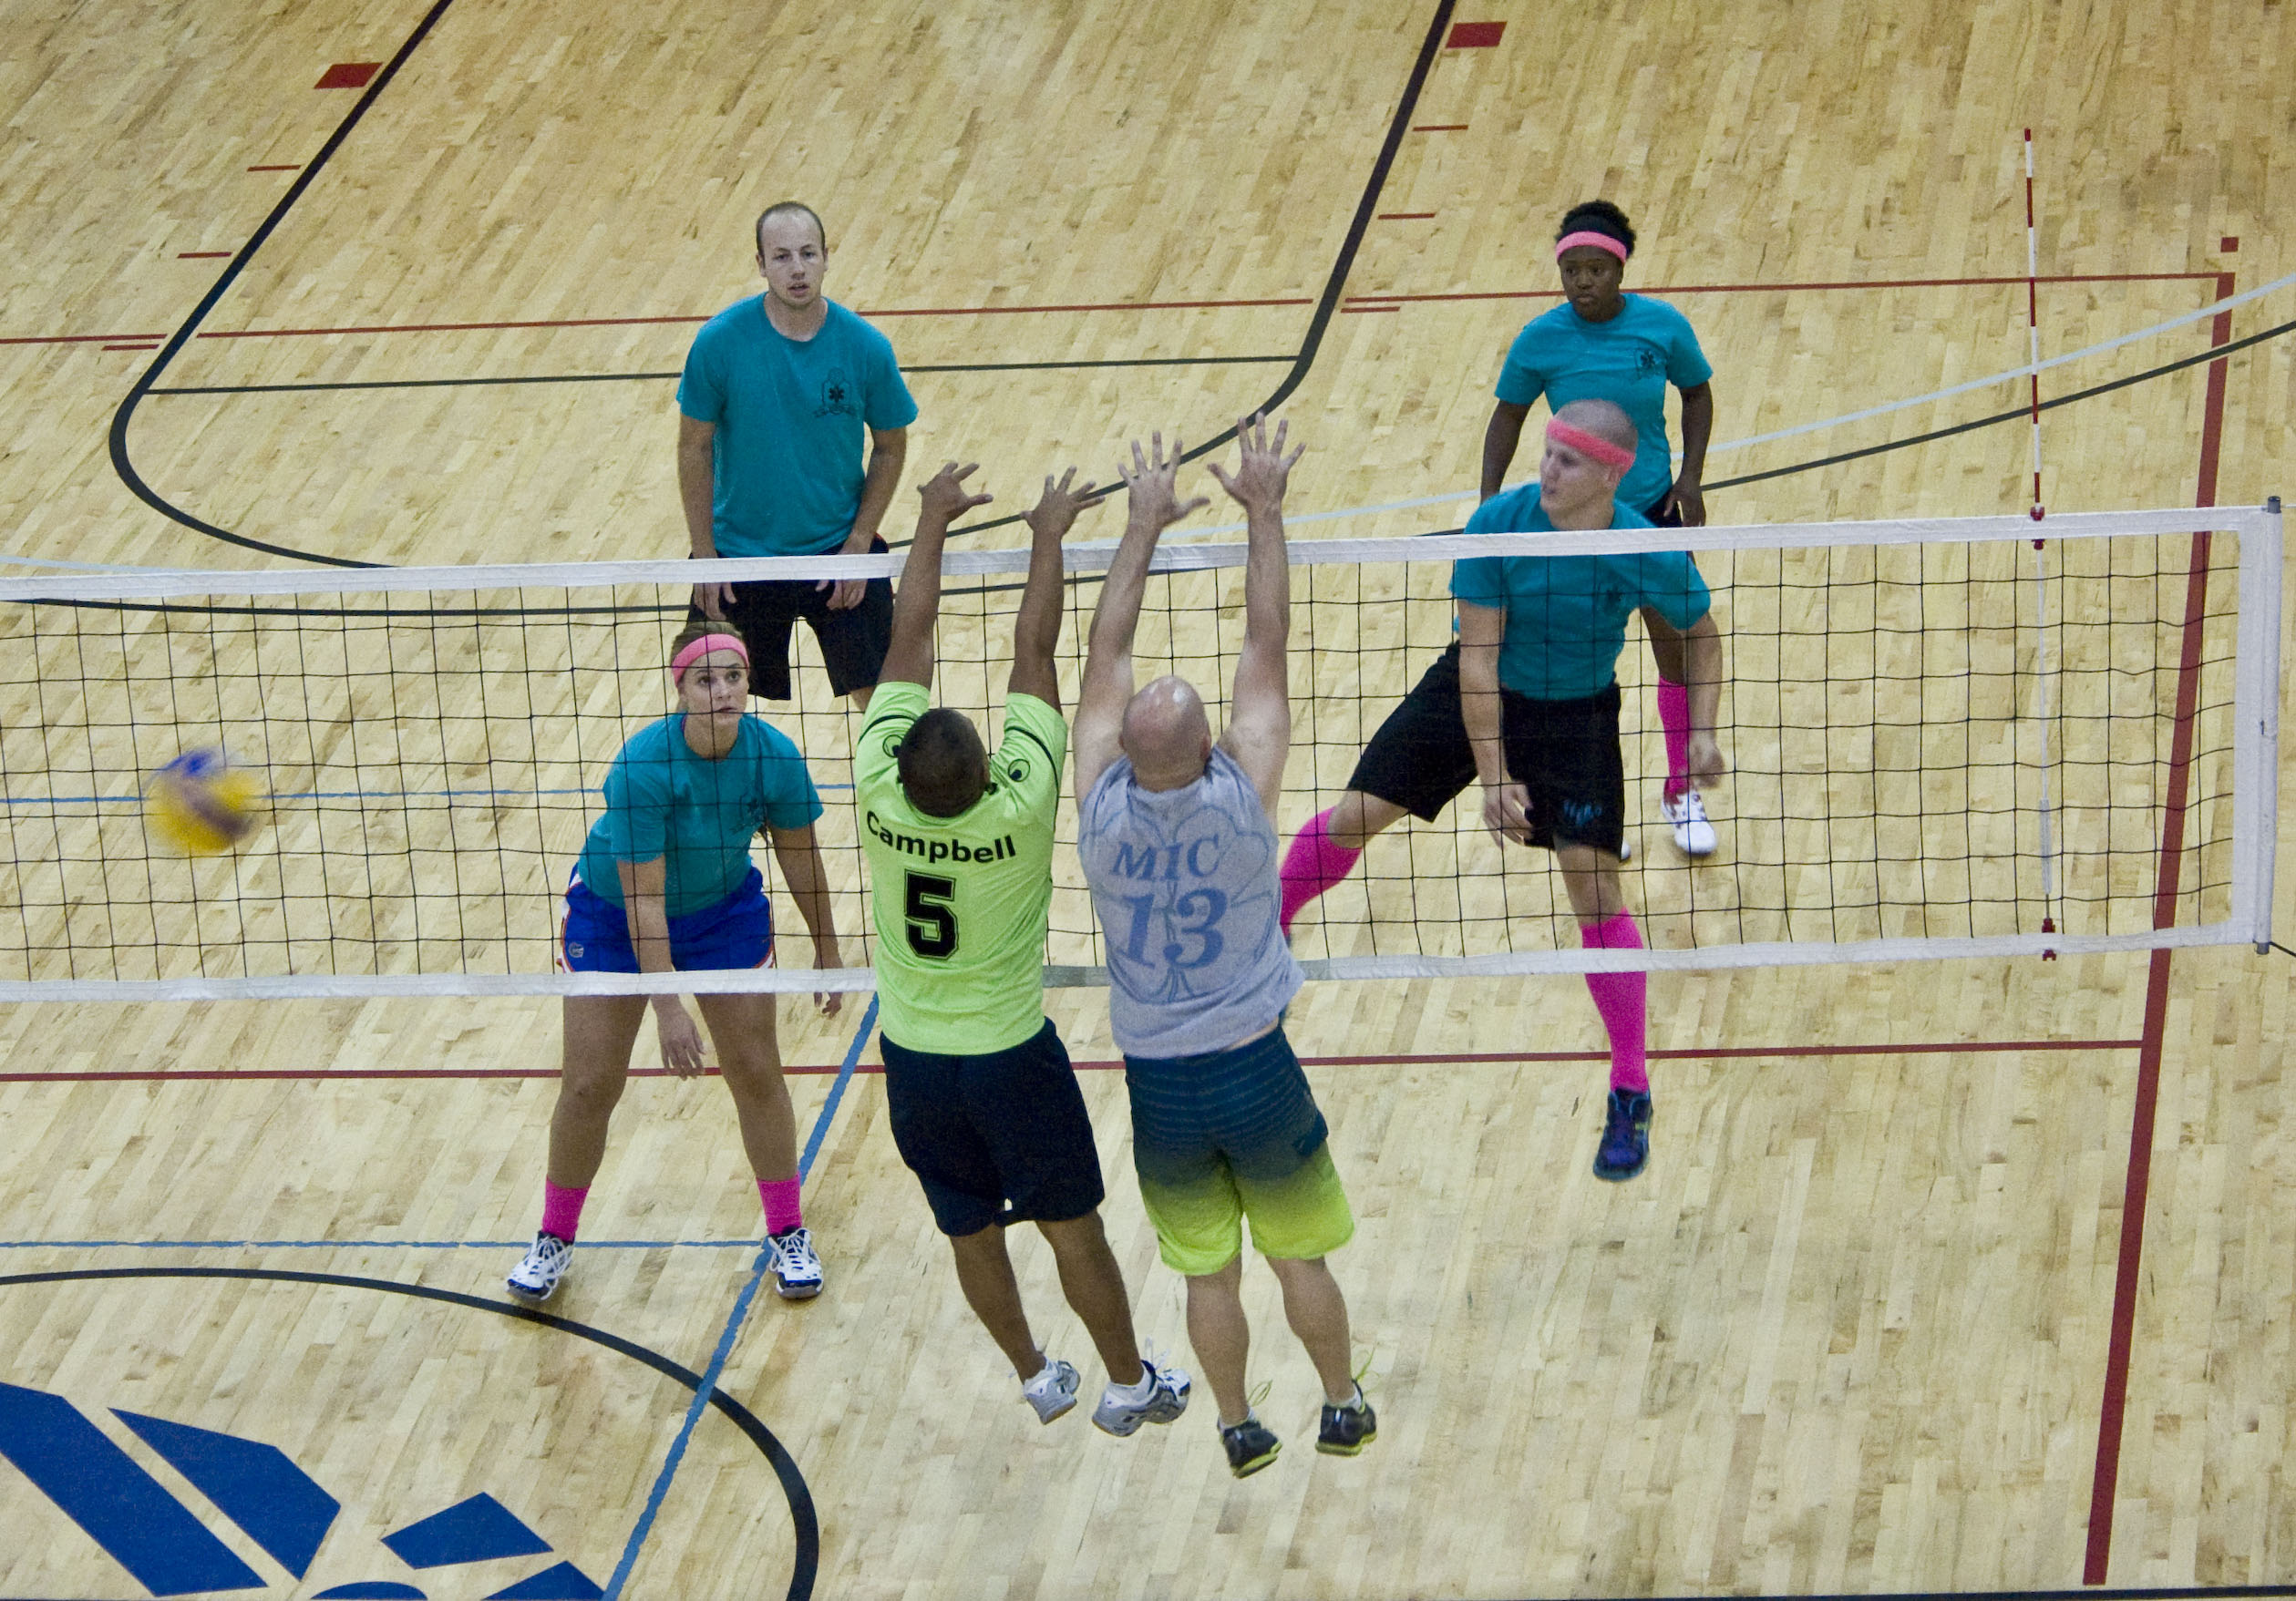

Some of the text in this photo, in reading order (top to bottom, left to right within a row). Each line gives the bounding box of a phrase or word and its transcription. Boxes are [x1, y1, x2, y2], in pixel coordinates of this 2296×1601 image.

[867, 810, 1016, 864] Campbell
[1108, 833, 1220, 881] MIC
[904, 868, 959, 960] 5
[1114, 887, 1228, 970] 13
